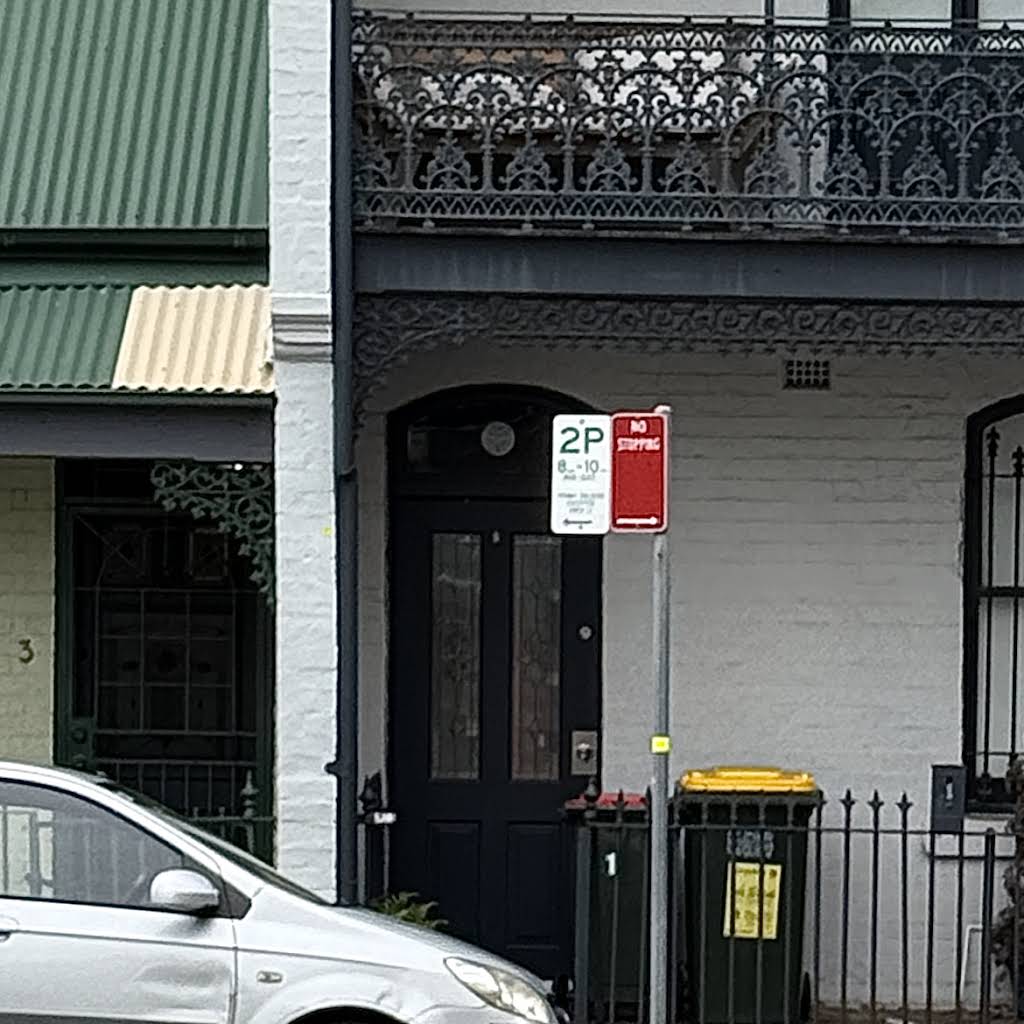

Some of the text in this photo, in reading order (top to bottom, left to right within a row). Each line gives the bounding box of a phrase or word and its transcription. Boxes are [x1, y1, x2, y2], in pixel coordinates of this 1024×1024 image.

[560, 427, 604, 454] 2P
[18, 638, 34, 663] 3
[604, 851, 617, 876] 1
